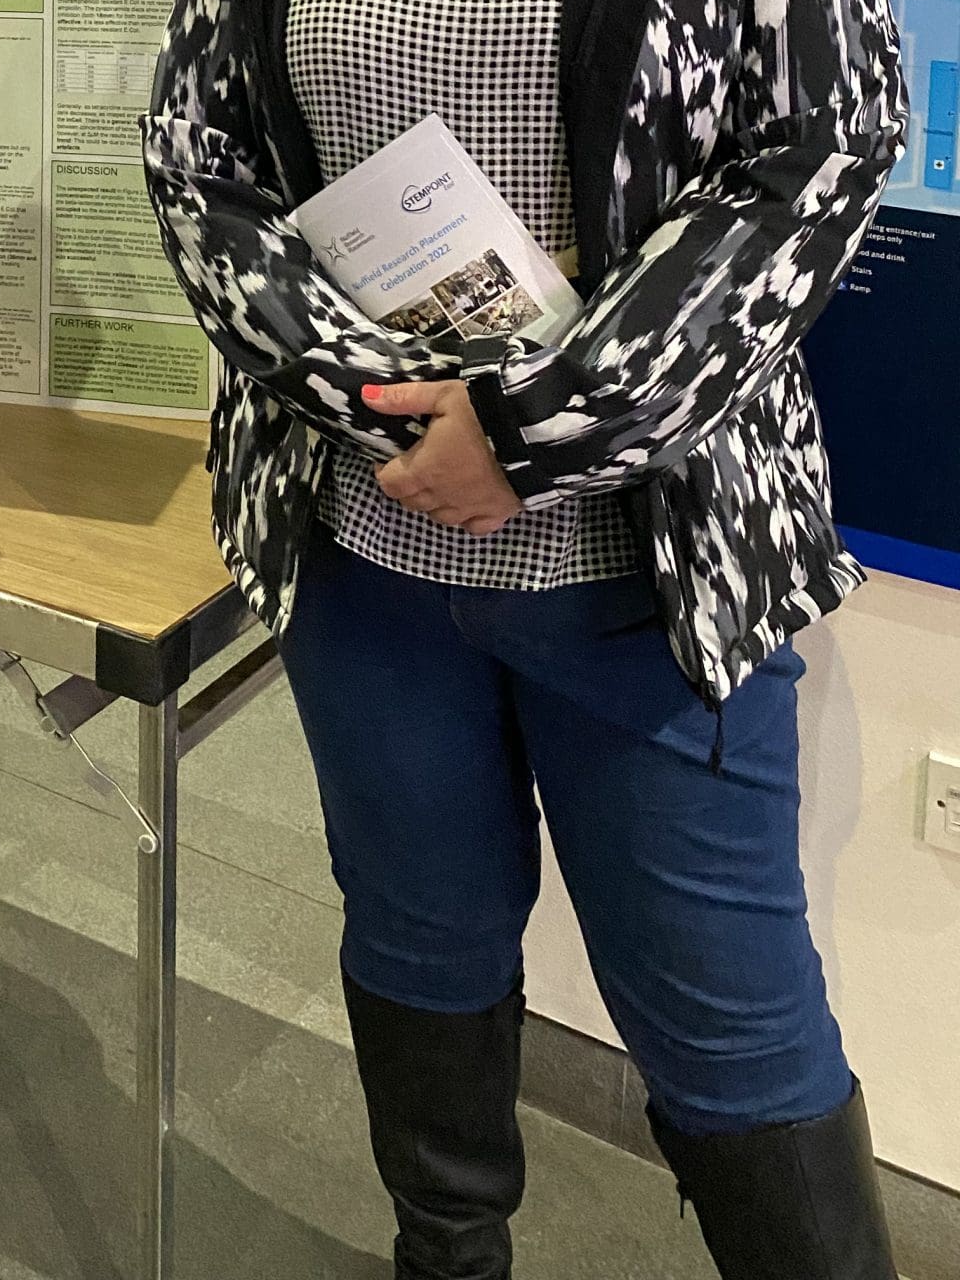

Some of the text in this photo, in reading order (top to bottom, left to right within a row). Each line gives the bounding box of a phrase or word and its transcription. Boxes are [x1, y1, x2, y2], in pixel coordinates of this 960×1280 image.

[56, 165, 118, 176] DISCUSSION
[404, 172, 451, 208] STEMPOINT
[886, 236, 903, 245] only
[352, 214, 467, 292] Nuffield Research Placement
[871, 251, 885, 259] and
[886, 254, 905, 262] drink
[380, 243, 452, 291] Celebration 2022
[852, 266, 872, 275] Stairs
[850, 283, 871, 294] Ramp
[55, 318, 135, 333] FURTHER WORK
